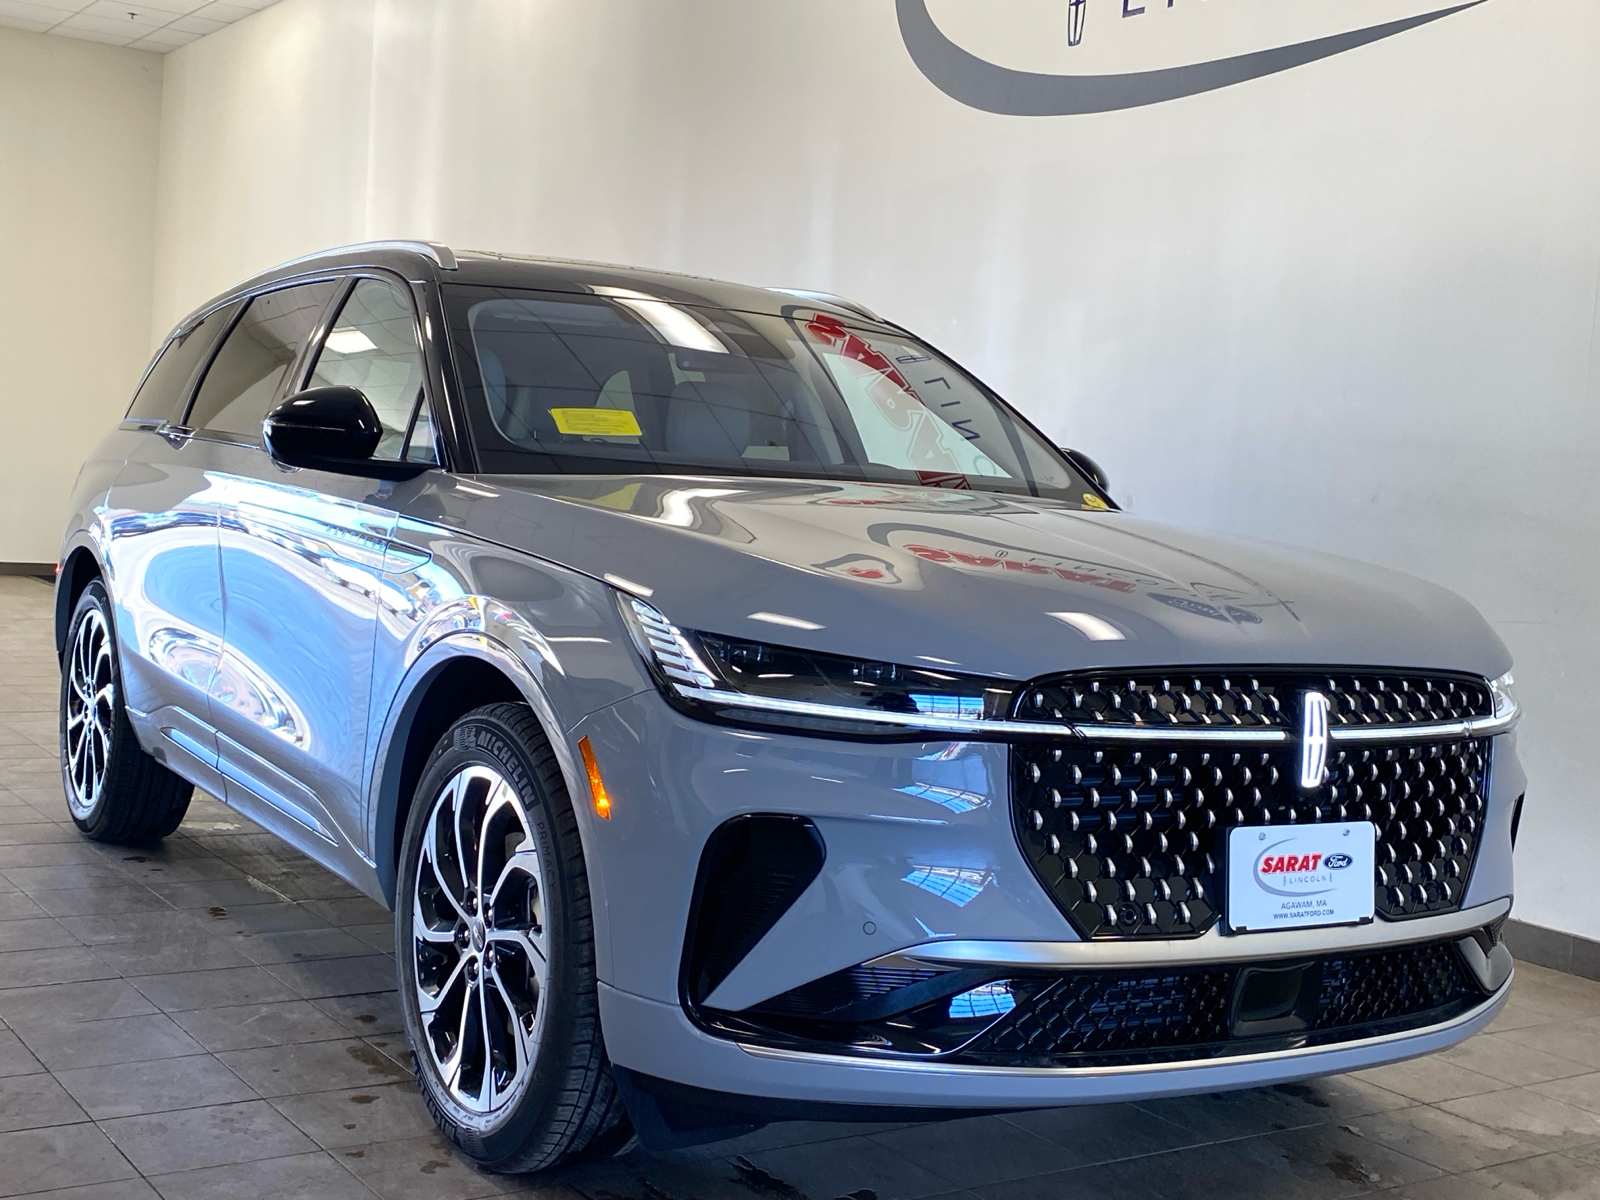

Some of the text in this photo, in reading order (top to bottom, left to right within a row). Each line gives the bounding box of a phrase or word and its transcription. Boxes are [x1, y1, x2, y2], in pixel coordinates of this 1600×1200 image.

[477, 730, 535, 805] MICHELIN
[537, 822, 556, 888] PRIMACY
[1261, 854, 1350, 874] SARAT Ford
[1289, 875, 1327, 884] LINCOLN
[1281, 899, 1327, 910] AGAWAM, MA
[1273, 909, 1334, 919] WWW.SARATFORD.COM
